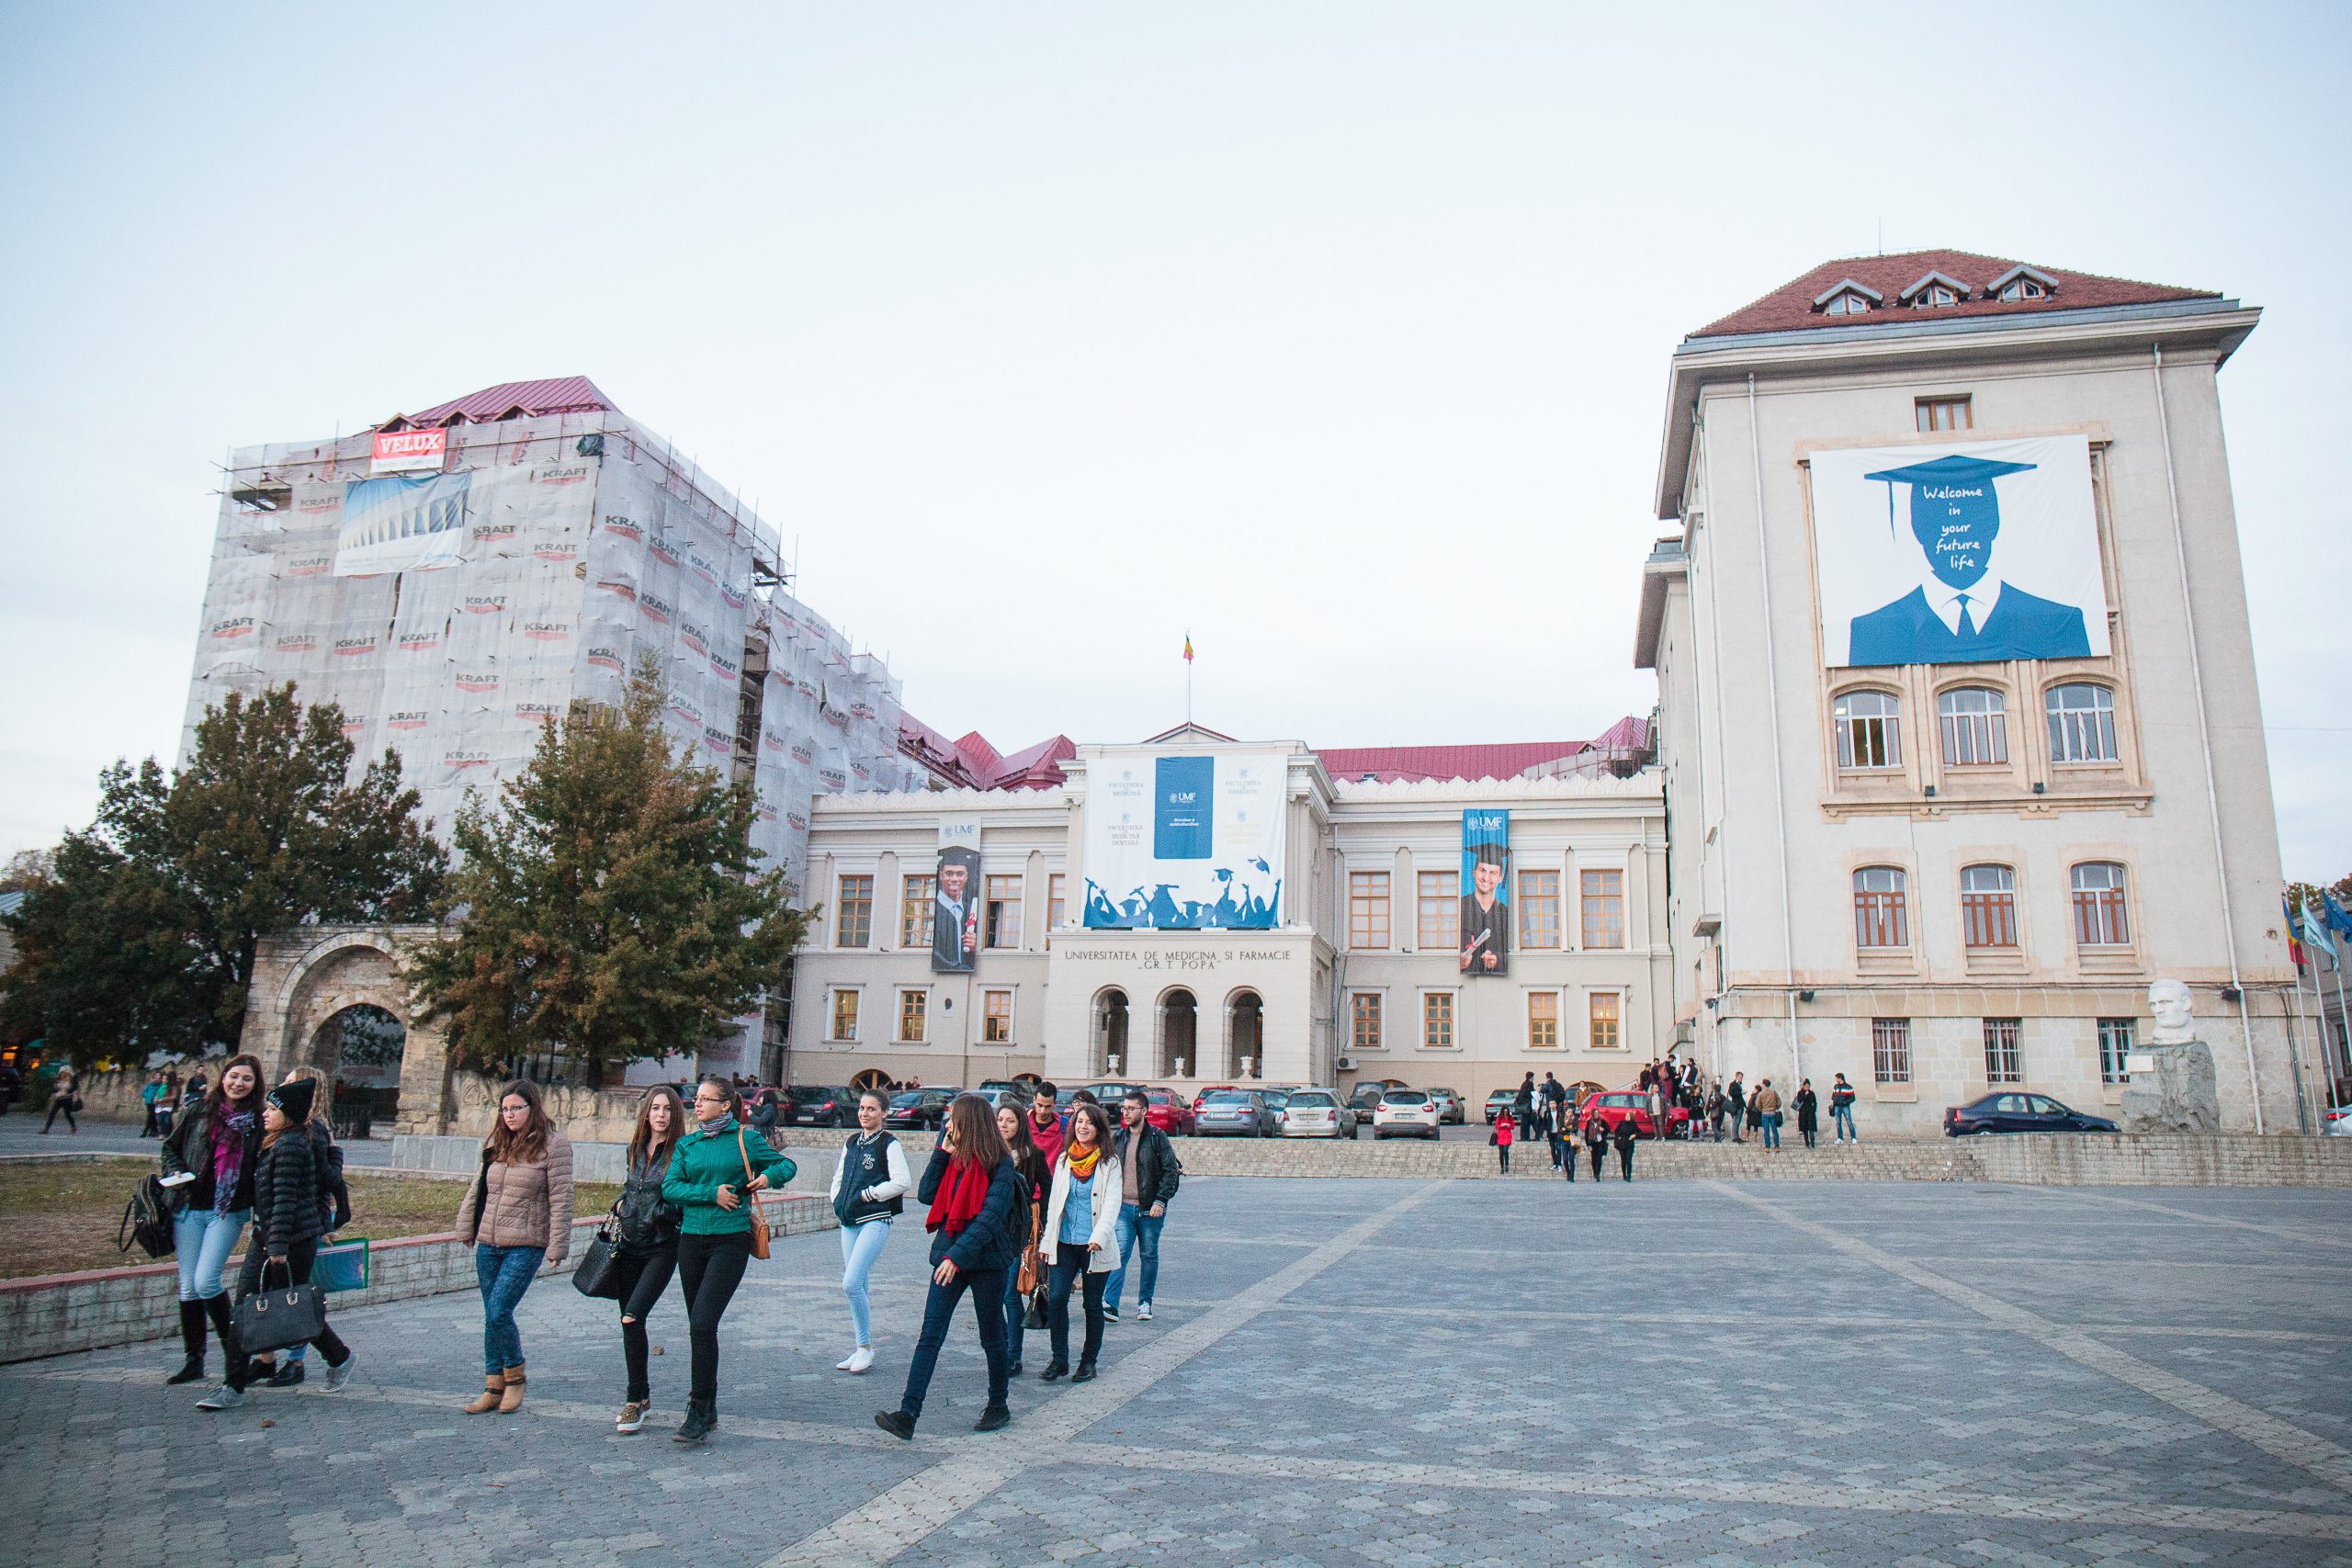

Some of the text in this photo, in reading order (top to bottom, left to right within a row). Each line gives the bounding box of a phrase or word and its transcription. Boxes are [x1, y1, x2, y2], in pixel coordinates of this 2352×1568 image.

[380, 434, 441, 455] VELUX
[543, 468, 588, 478] KRAFT
[1923, 485, 1983, 500] Welcome
[300, 497, 341, 508] KRAFT
[1948, 502, 1961, 516] in
[473, 525, 515, 535] KRAFT
[1941, 522, 1972, 537] your
[535, 544, 577, 553] KRAFT
[650, 535, 680, 559] KRAFT
[1935, 538, 1981, 555] future
[289, 558, 330, 569] KRAFT
[1950, 555, 1975, 570] life
[722, 581, 746, 602] KRAFT
[213, 617, 254, 632] KRAFT
[525, 623, 569, 632] KRAFT
[277, 635, 317, 645] KRAFT
[335, 637, 377, 648] KRAFT
[399, 633, 439, 643] KRAFT
[711, 652, 737, 671] KRAFT
[456, 673, 499, 683] KRAFT
[515, 704, 561, 713] KRAFT
[389, 711, 429, 721] KRAFT
[707, 726, 731, 744] KRAFT
[446, 751, 489, 761] KRAFT
[820, 769, 845, 781] KRAFT
[1479, 817, 1502, 827] UMF
[955, 825, 976, 834] UMF
[1065, 951, 1291, 961] UNIVERSITATEA DE MEDICINA SI FARMACIE
[1167, 960, 1173, 970] T.
[862, 1153, 876, 1169] 75
